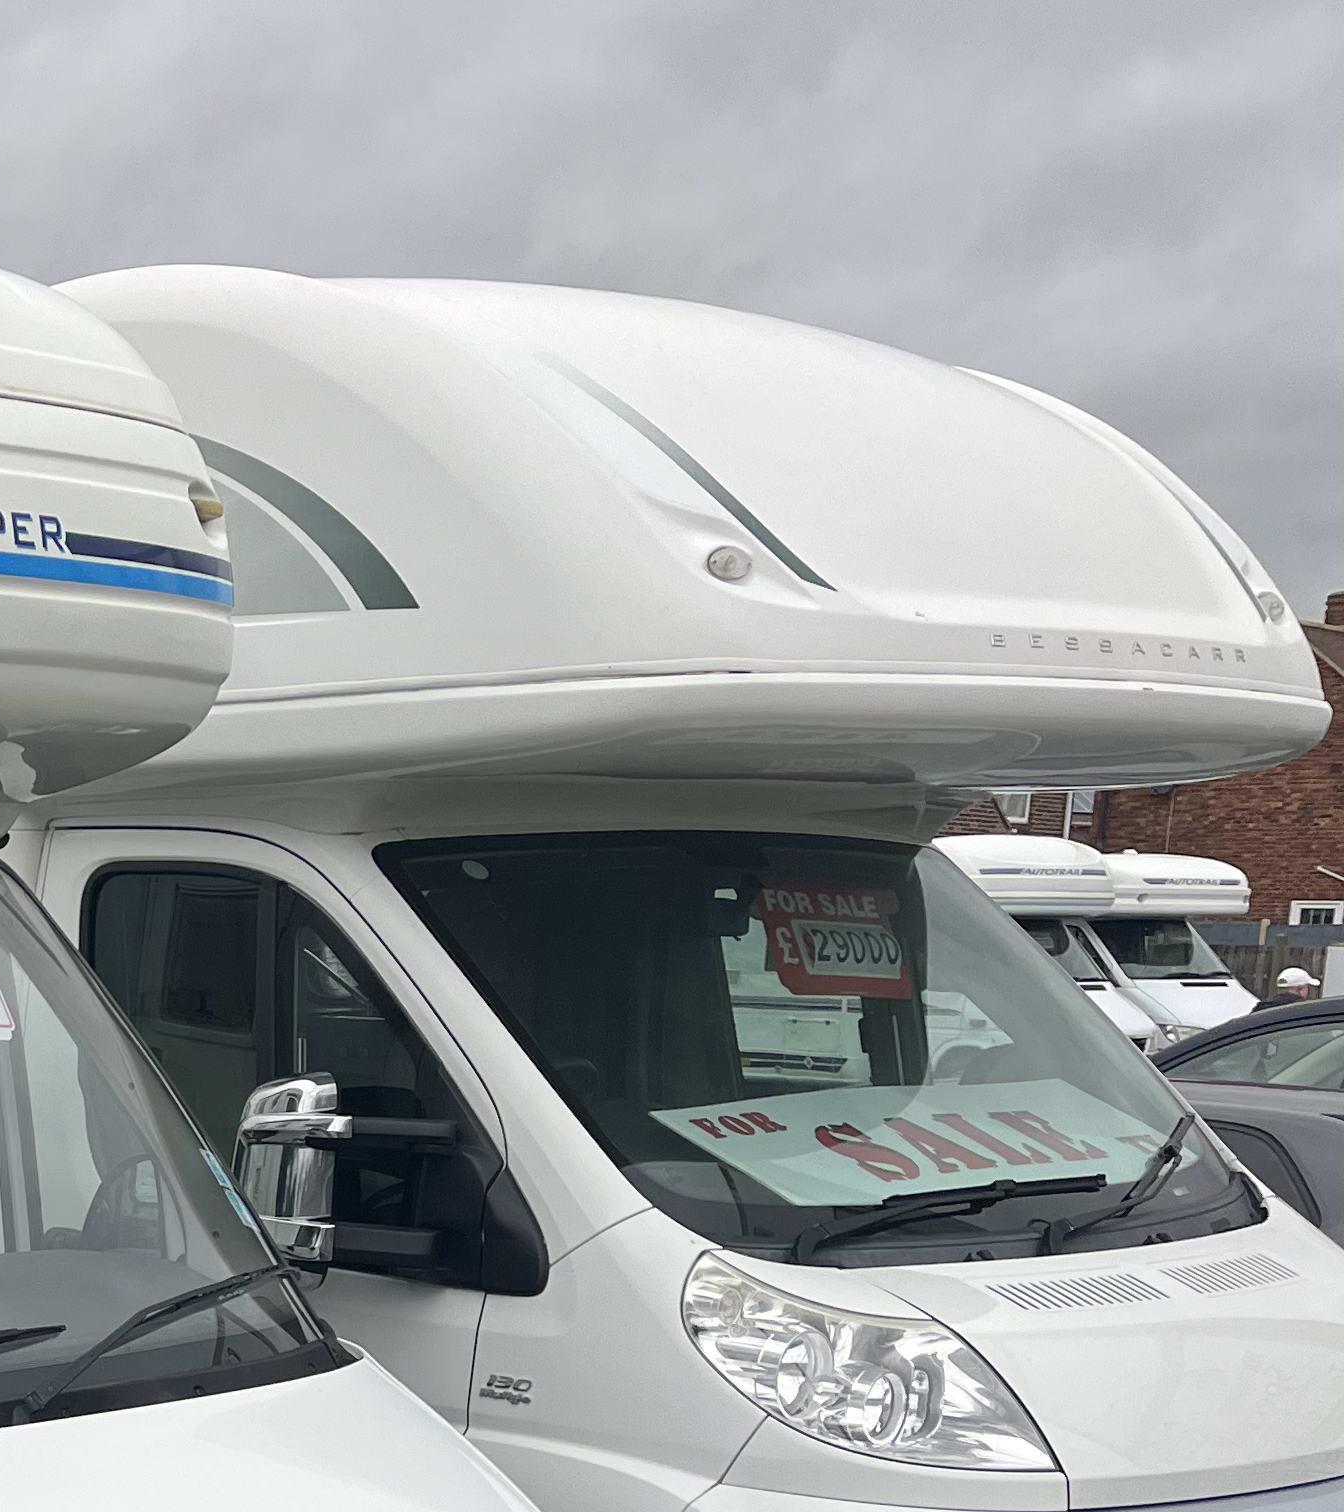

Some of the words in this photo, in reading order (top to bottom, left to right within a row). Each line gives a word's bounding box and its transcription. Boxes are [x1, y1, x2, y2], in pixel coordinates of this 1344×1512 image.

[990, 632, 1246, 663] BESSACARR
[762, 888, 815, 914] FOR
[817, 893, 881, 919] SALE
[688, 1110, 788, 1139] FOR
[814, 1109, 1108, 1183] SALE
[486, 1374, 533, 1392] 130
